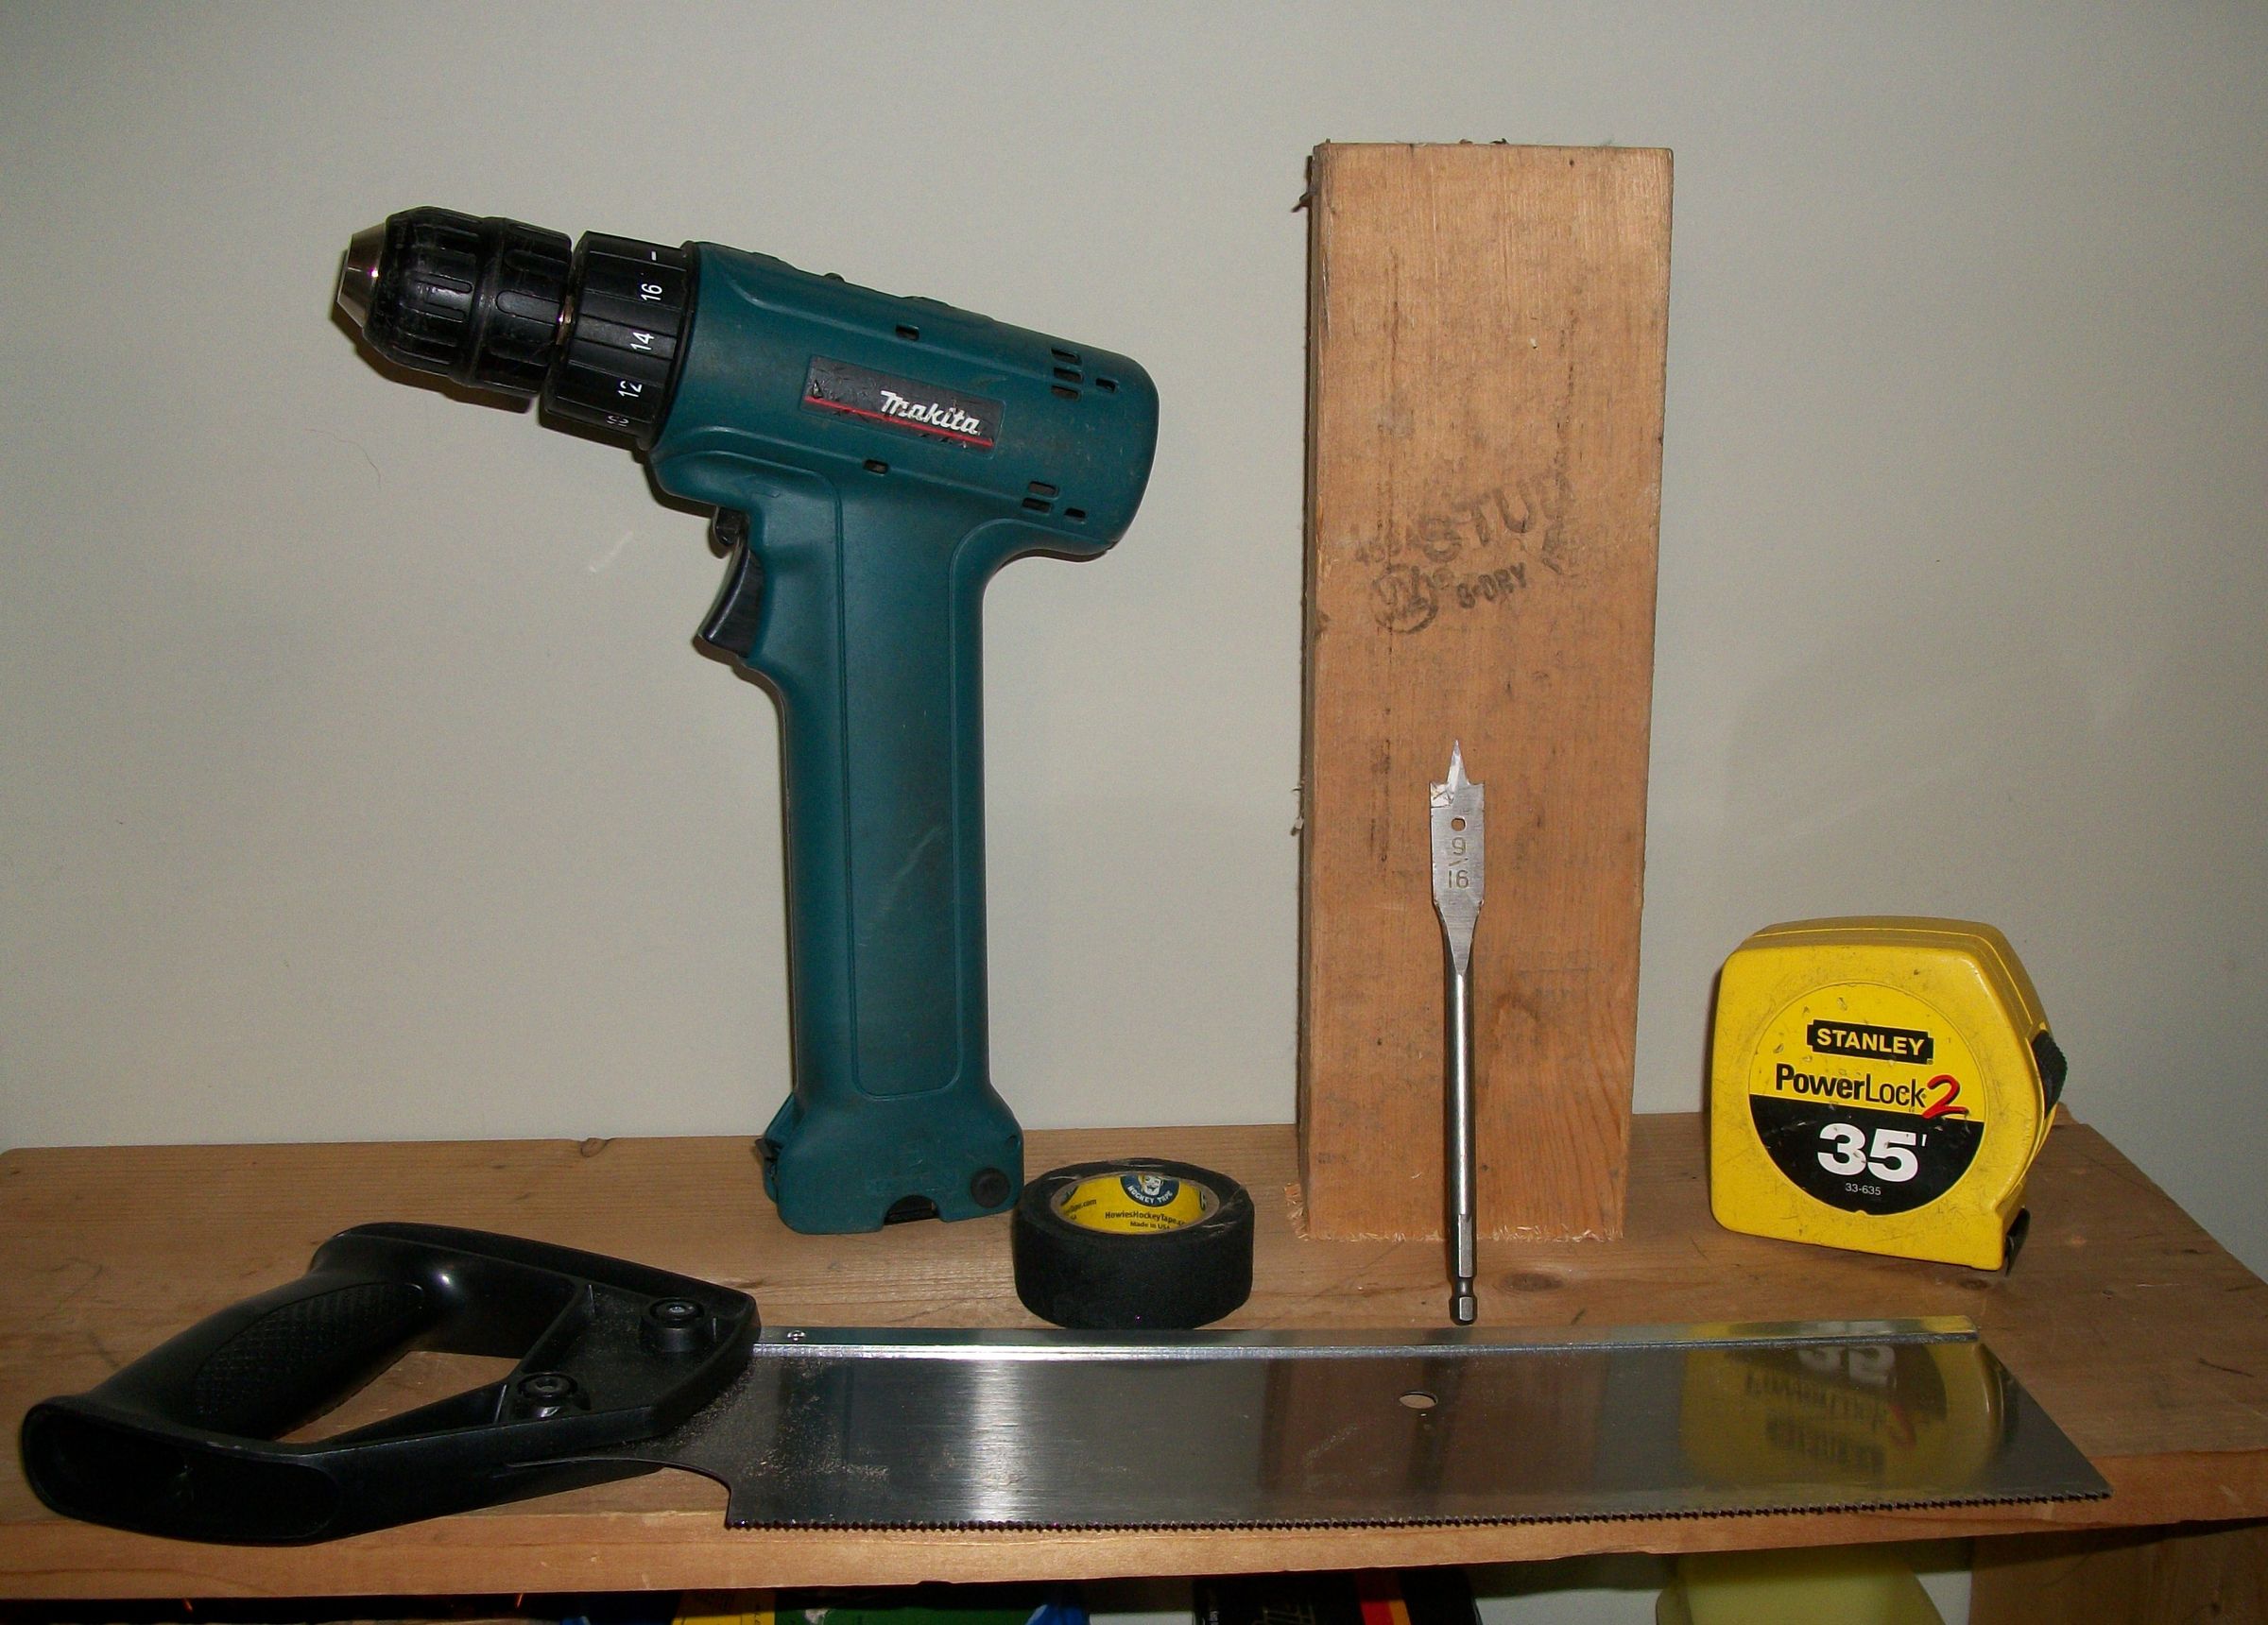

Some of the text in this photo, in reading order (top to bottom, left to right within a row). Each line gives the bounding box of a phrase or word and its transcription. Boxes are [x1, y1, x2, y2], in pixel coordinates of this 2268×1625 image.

[640, 282, 663, 301] 16
[630, 332, 655, 351] 14
[617, 380, 643, 398] 12
[1816, 1027, 1925, 1056] STANLEY
[1126, 1185, 1174, 1204] HOCKEY TAPE
[1845, 1182, 1881, 1196] 33-635
